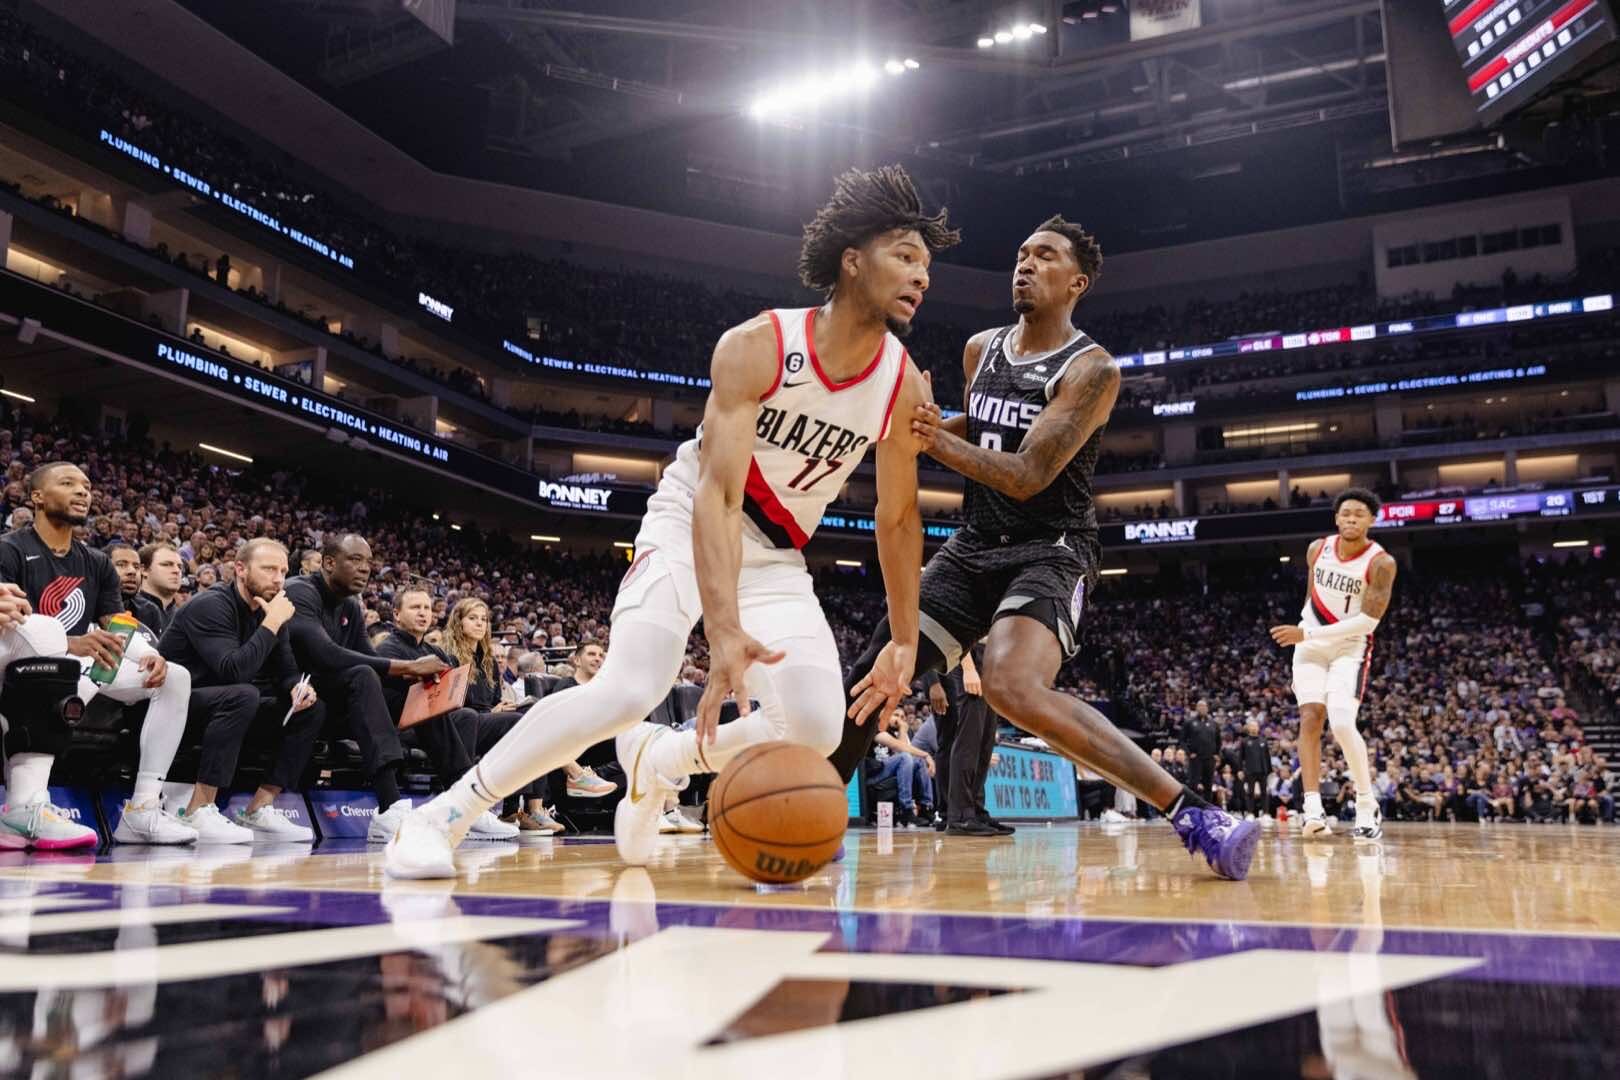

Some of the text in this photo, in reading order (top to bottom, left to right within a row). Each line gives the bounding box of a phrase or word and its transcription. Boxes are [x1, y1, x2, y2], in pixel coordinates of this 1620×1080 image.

[100, 129, 354, 269] PLUMBING SEWER ELECTRICAL HEATING & AIR
[992, 337, 1001, 349] 6
[543, 357, 574, 370] SEWER
[584, 363, 638, 379] ELECTRICAL
[647, 371, 686, 385] HEATING
[696, 378, 712, 387] AIR
[788, 354, 801, 371] 6
[157, 343, 449, 462] PLUMBING SEWER ELECTRICAL HEATING & AIR
[787, 458, 843, 492] 17
[538, 480, 613, 506] BONNEY
[1489, 498, 1517, 511] SAC
[1125, 520, 1198, 539] BONNEY
[1316, 567, 1362, 595] BLAZERS
[1344, 594, 1352, 614] 1
[1020, 755, 1027, 779] A
[993, 783, 1016, 809] WAY
[1019, 785, 1032, 809] TO
